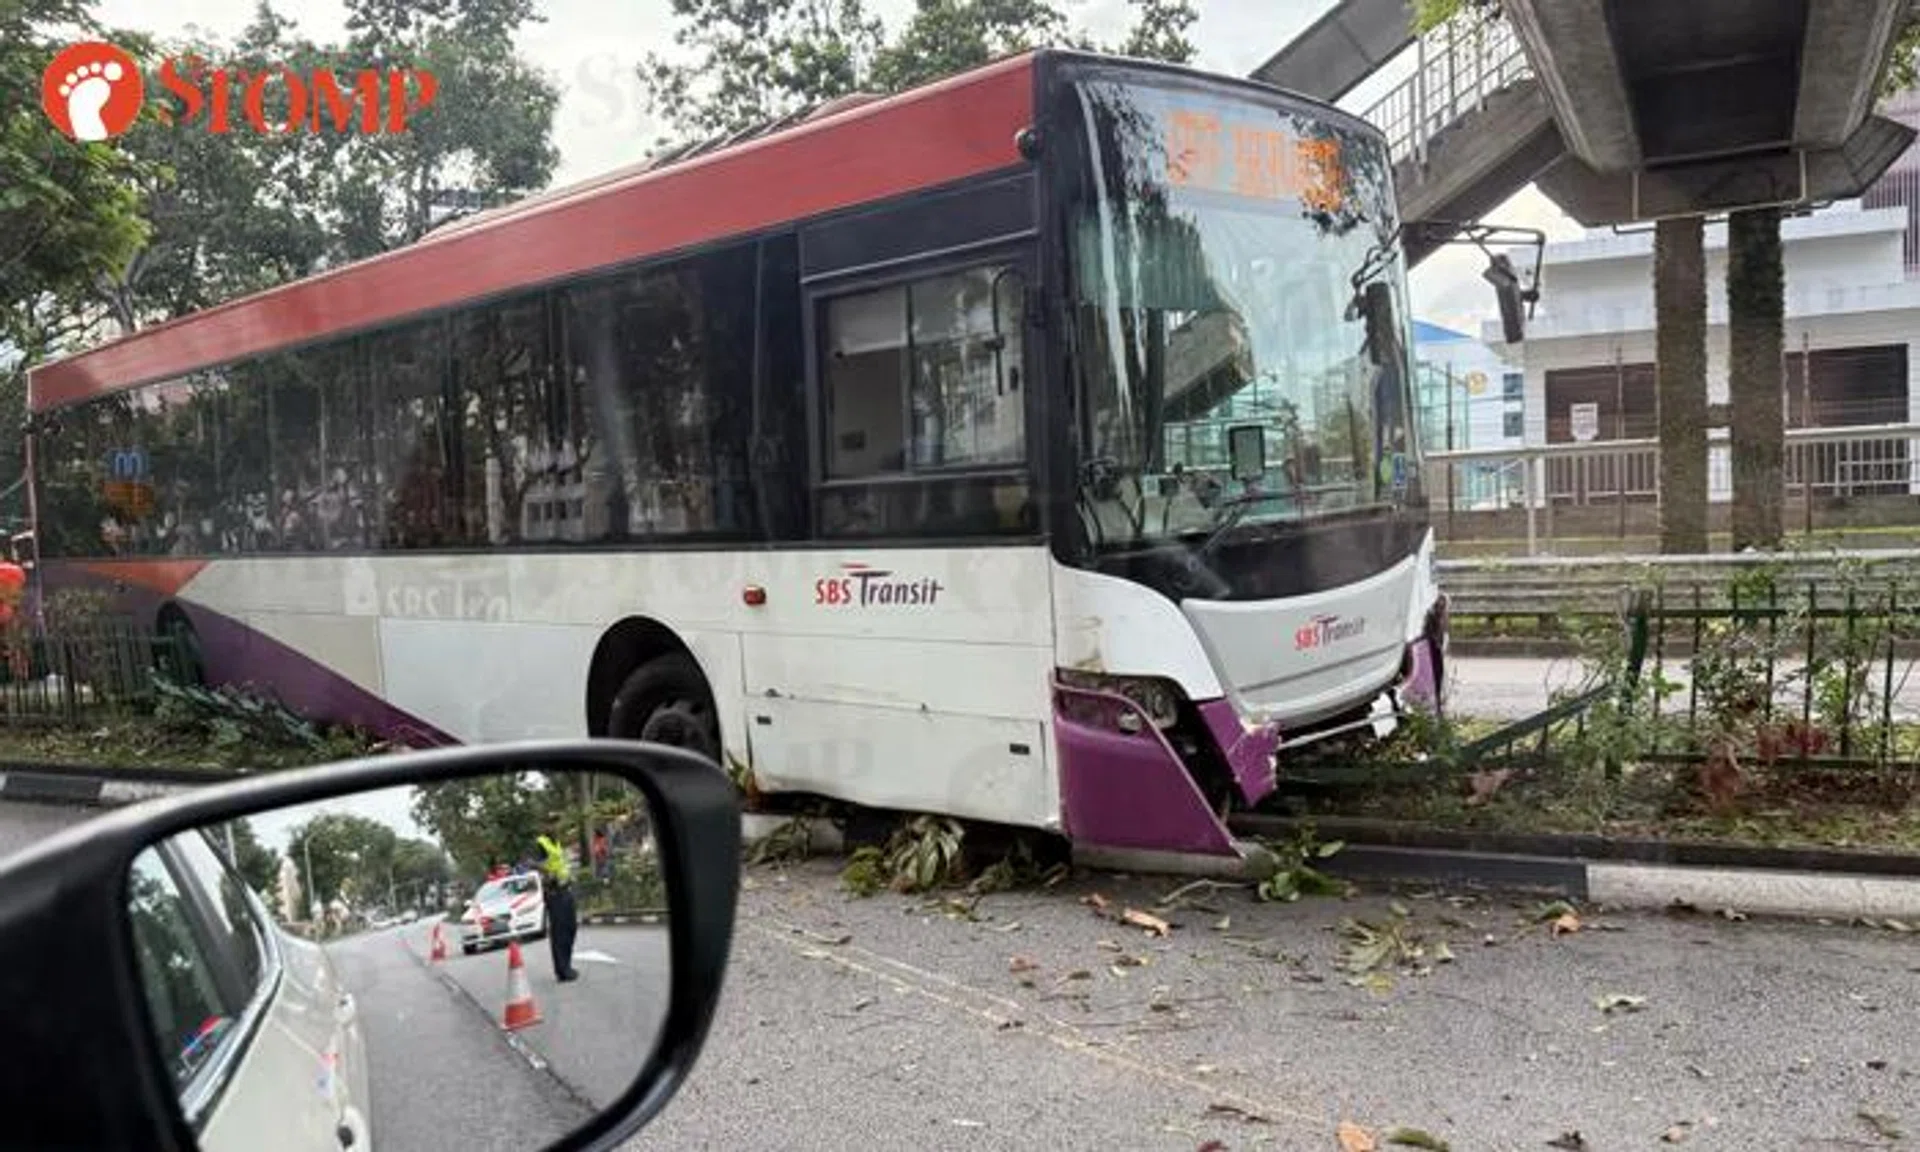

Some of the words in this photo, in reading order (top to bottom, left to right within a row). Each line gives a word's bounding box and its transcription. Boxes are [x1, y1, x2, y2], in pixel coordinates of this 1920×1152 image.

[815, 578, 852, 605] SBS
[848, 570, 945, 608] Transit
[1295, 627, 1319, 650] SBS
[1316, 615, 1365, 647] Transit
